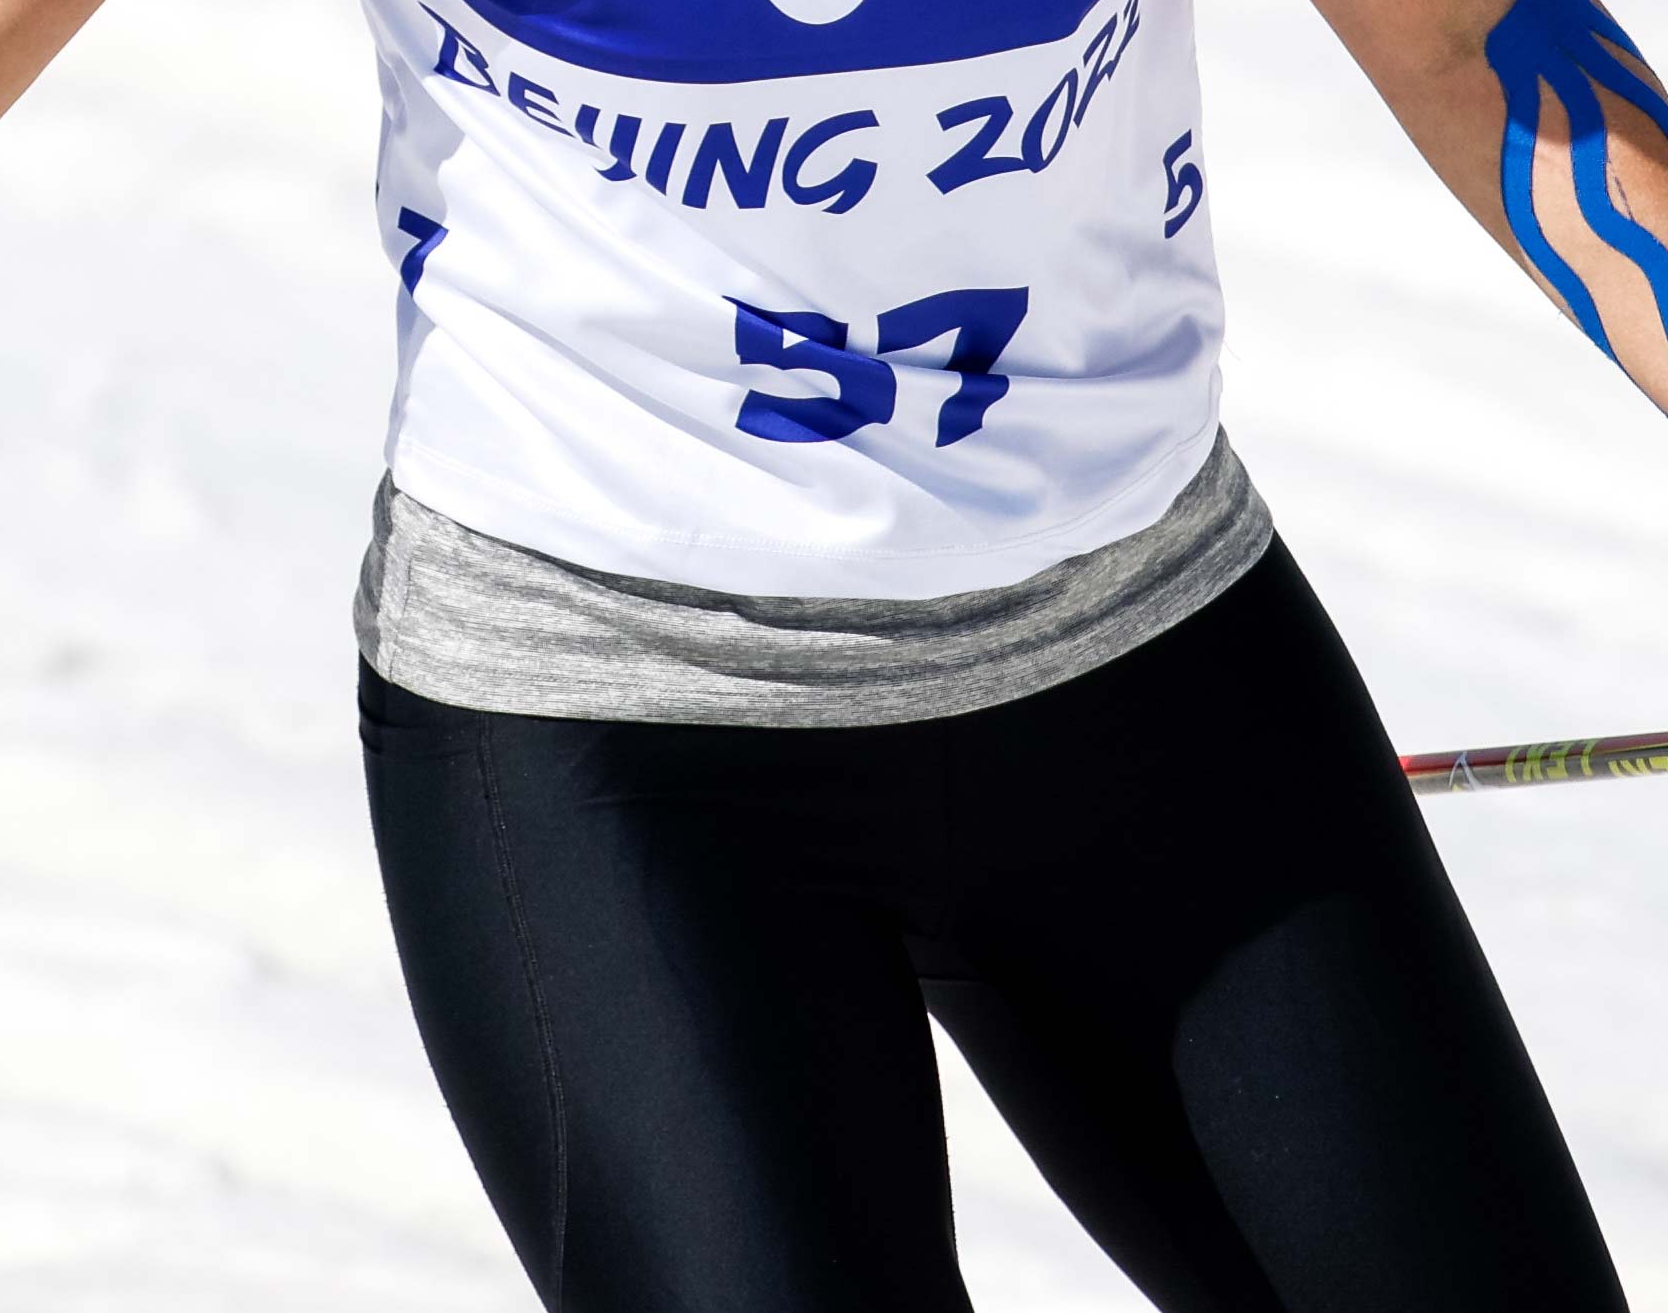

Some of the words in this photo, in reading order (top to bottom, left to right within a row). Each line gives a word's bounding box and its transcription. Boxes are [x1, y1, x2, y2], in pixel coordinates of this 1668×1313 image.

[417, 0, 881, 215] BEIJING
[1162, 128, 1204, 240] 5
[721, 285, 1030, 449] 57
